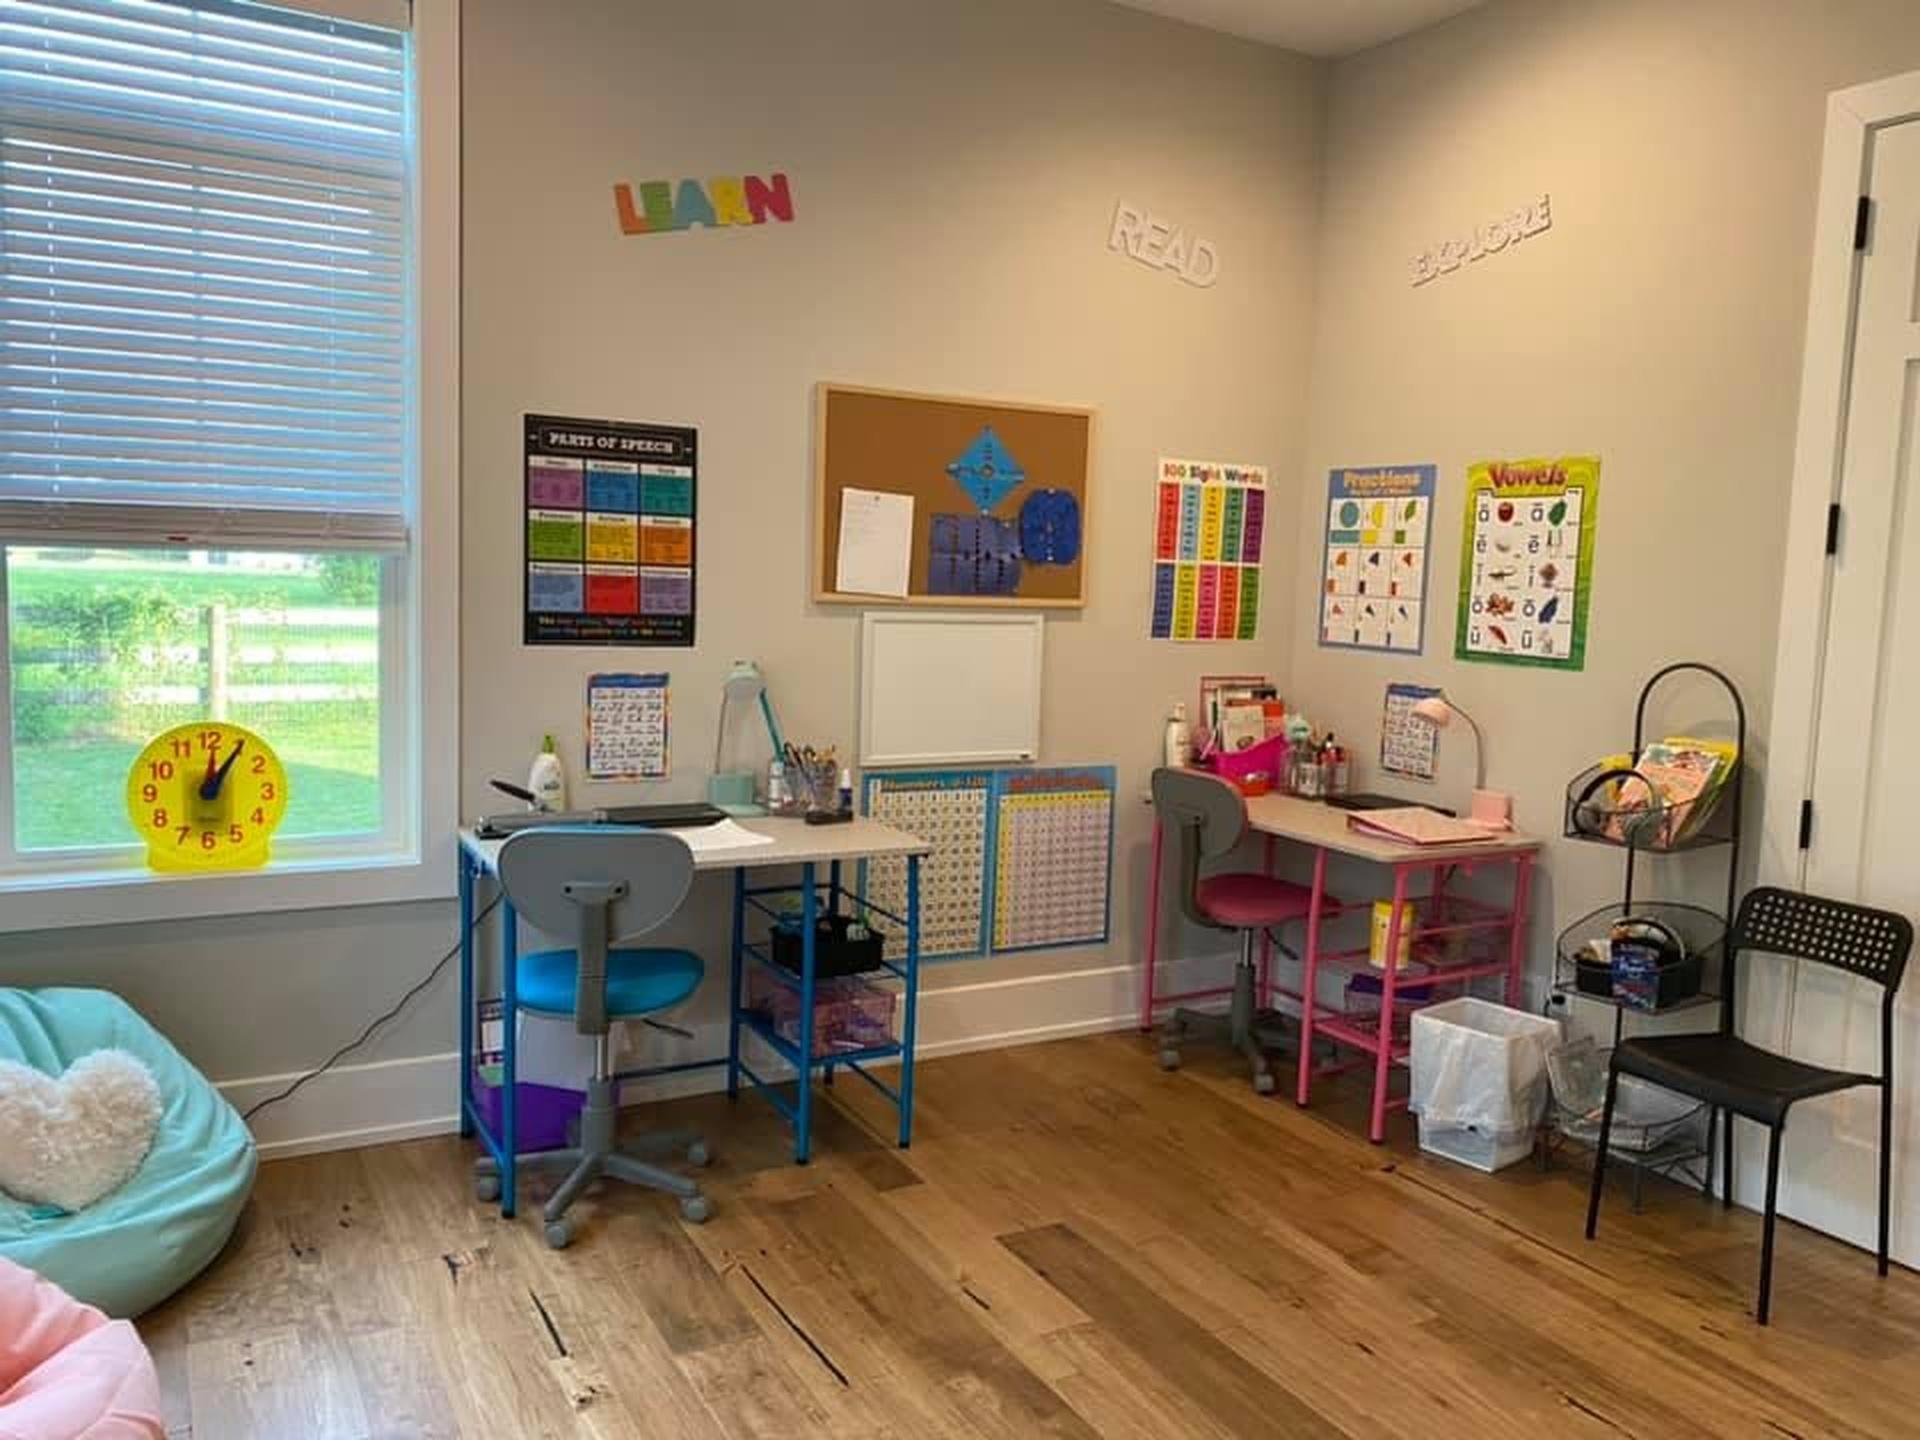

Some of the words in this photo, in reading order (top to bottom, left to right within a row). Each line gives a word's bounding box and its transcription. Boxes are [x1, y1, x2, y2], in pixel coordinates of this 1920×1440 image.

[614, 173, 794, 235] LEARN
[1108, 198, 1218, 289] READ
[1411, 192, 1552, 288] EXPLORE
[549, 431, 595, 447] PARTS
[596, 436, 616, 449] OF
[620, 437, 673, 454] SPEECH
[1164, 463, 1186, 478] 100
[1189, 464, 1221, 483] Sight
[1224, 467, 1263, 484] Words
[1488, 463, 1568, 489] Vowels
[170, 740, 192, 758] 11
[196, 731, 222, 750] 12
[149, 761, 174, 780] 10
[252, 755, 266, 774] 2
[143, 784, 157, 803] 9
[261, 782, 274, 801] 3
[153, 808, 168, 828] 8
[251, 807, 264, 825] 4
[176, 825, 192, 845] 7
[201, 831, 216, 850] 6
[229, 824, 243, 843] 5
